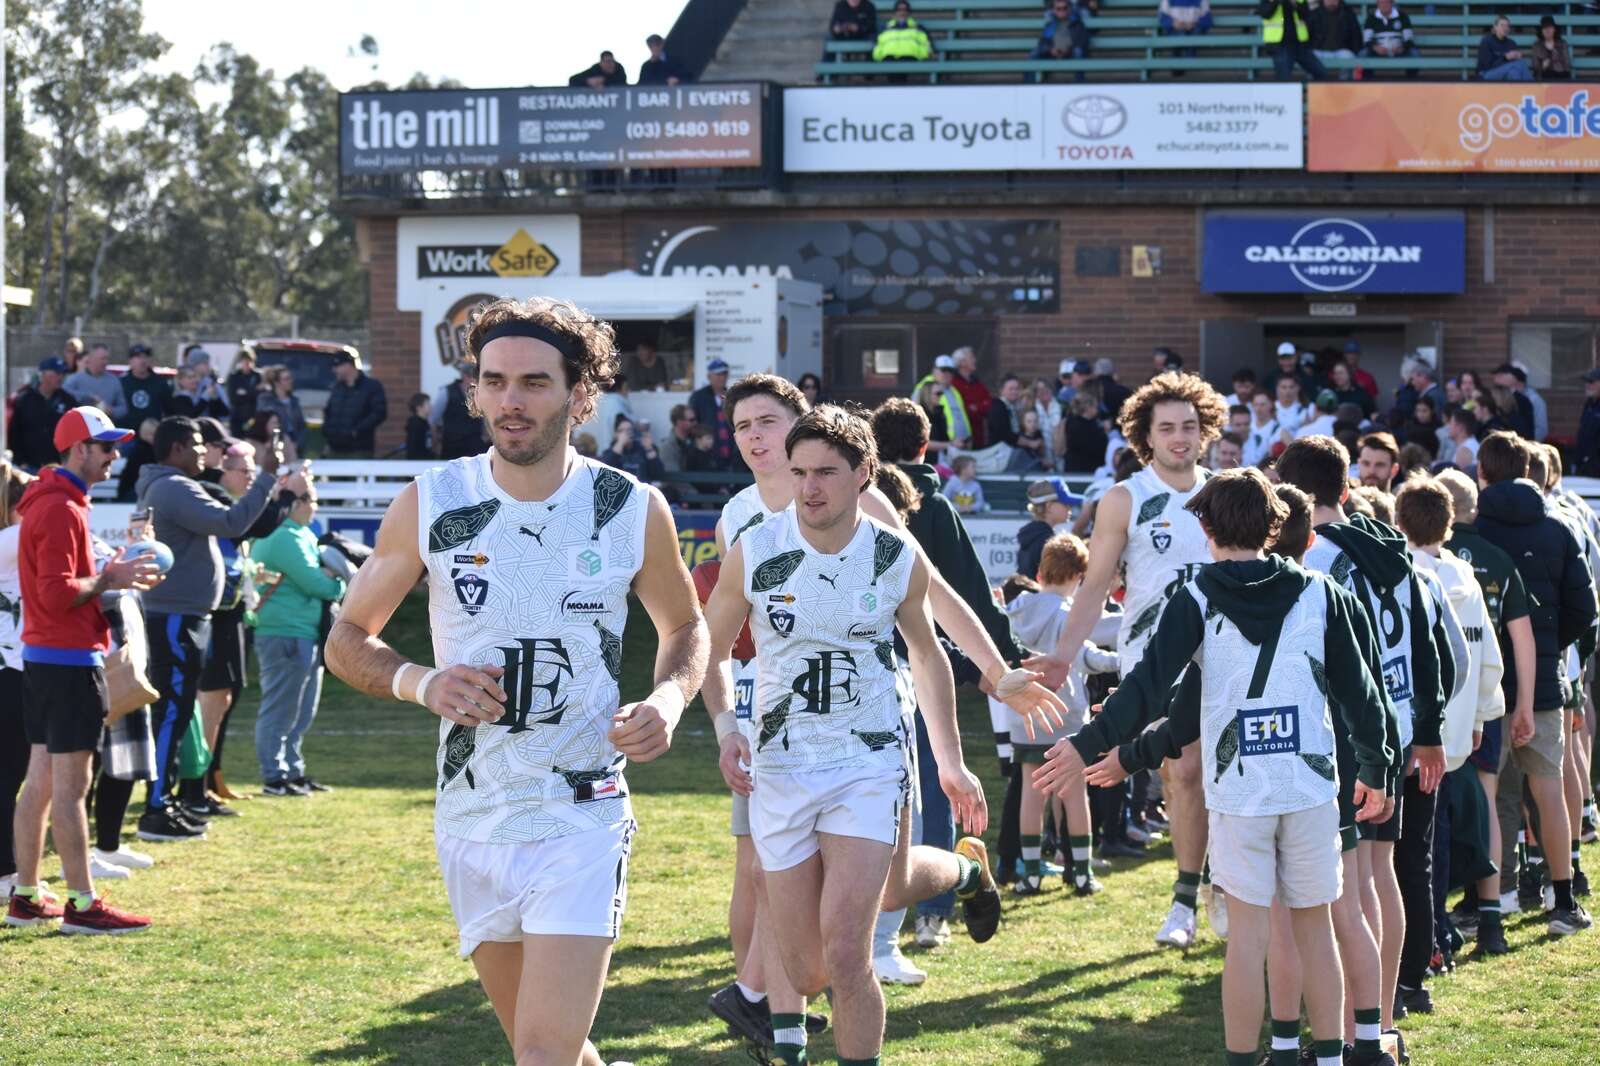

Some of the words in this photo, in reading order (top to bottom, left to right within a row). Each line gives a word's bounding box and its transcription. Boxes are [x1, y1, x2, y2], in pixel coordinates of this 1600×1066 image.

[519, 93, 618, 110] RESTAURANT
[638, 93, 670, 108] BAR
[689, 91, 751, 107] EVENTS
[1159, 102, 1184, 114] 101
[1187, 102, 1249, 114] Northern
[350, 101, 418, 149] the
[426, 98, 499, 147] mill
[627, 121, 660, 140] (03)
[665, 121, 708, 138] 5480
[714, 120, 751, 137] 1619
[802, 117, 914, 142] Echuca
[923, 116, 1032, 147] Toyota
[1057, 145, 1134, 160] TOYOTA
[1157, 140, 1289, 154] echucatoyota.com.au
[426, 249, 549, 272] WorkSafe
[1245, 246, 1421, 262] CALEDONIAN
[1308, 265, 1357, 275] HOTEL
[990, 533, 1015, 545] Elec
[567, 602, 604, 610] MOAMA
[1244, 712, 1294, 741] ETU
[1245, 741, 1294, 752] VICTORIA
